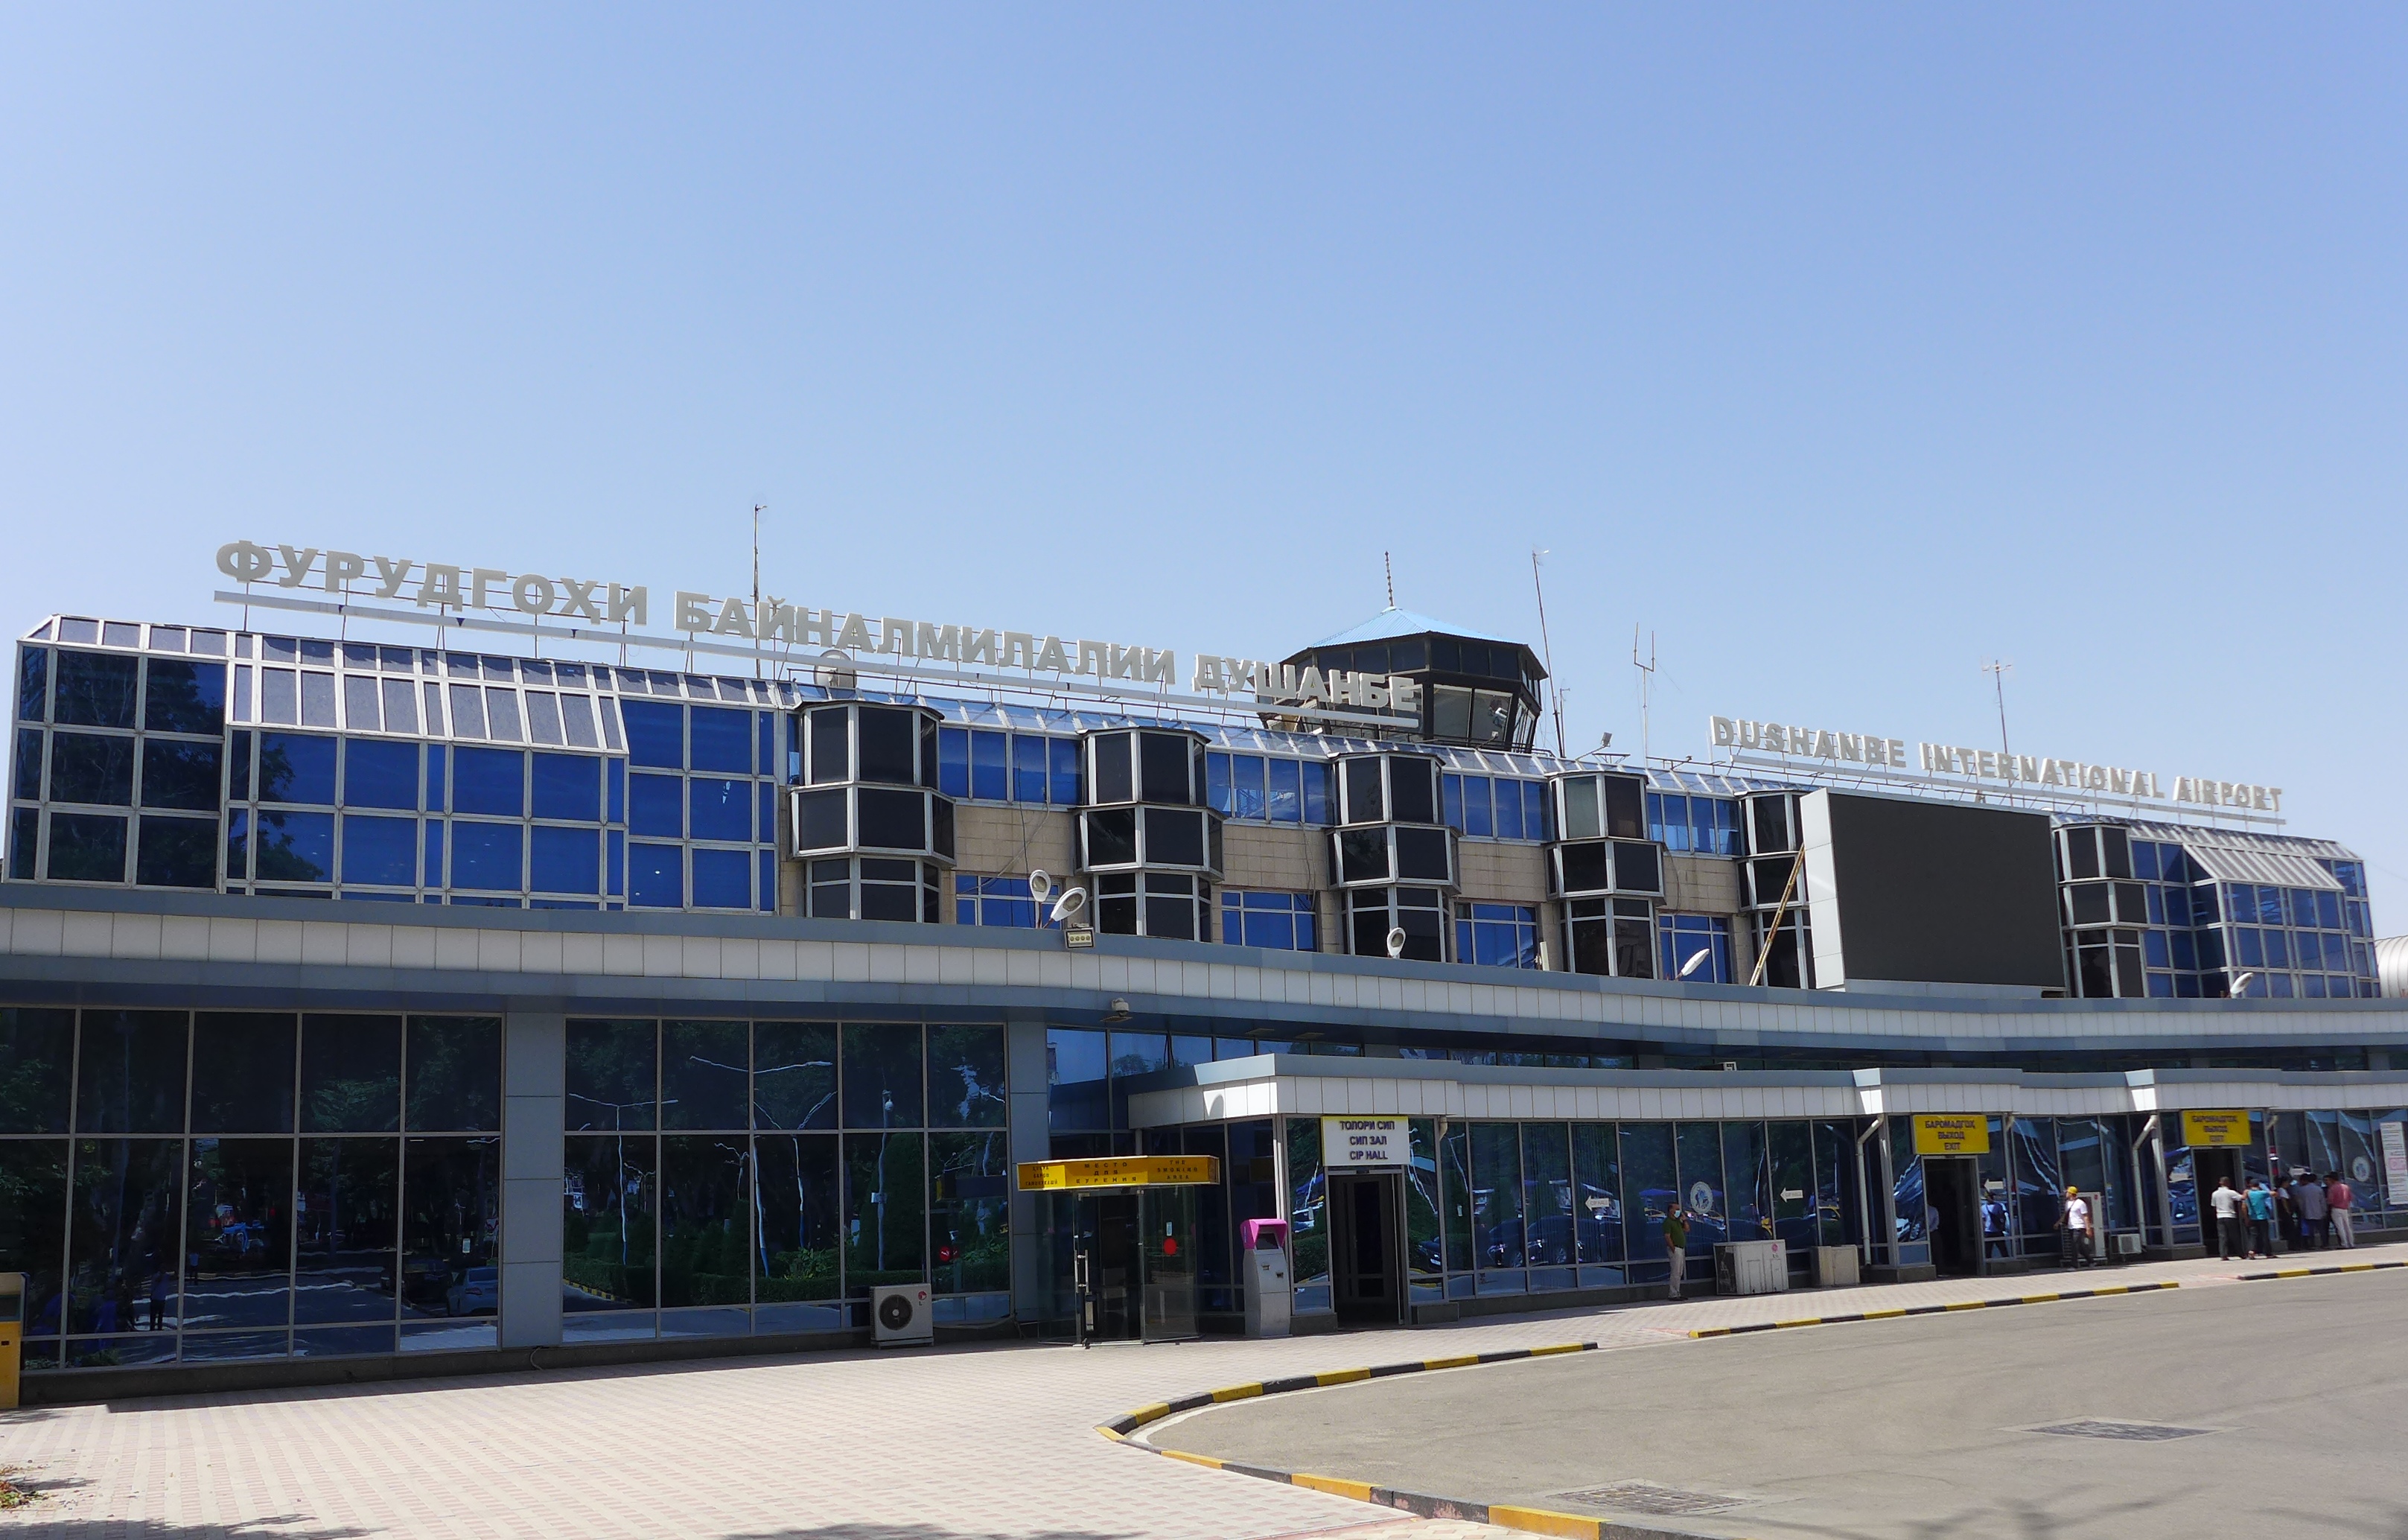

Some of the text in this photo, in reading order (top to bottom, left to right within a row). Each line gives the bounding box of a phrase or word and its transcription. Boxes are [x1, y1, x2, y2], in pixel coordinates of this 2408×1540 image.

[216, 540, 1418, 713] ФУРУДГОҲИ БАЙНАЛМИЛАЛИИ ДУШАНБЕ
[1710, 715, 2282, 812] DUSHANBE INTERNATIONAL AIRPORT
[1377, 1120, 1395, 1130] СИП
[1349, 1135, 1387, 1145] СИП ЗАЛ
[1944, 1142, 1961, 1151] EXIT
[1349, 1150, 1389, 1160] CIP HALL
